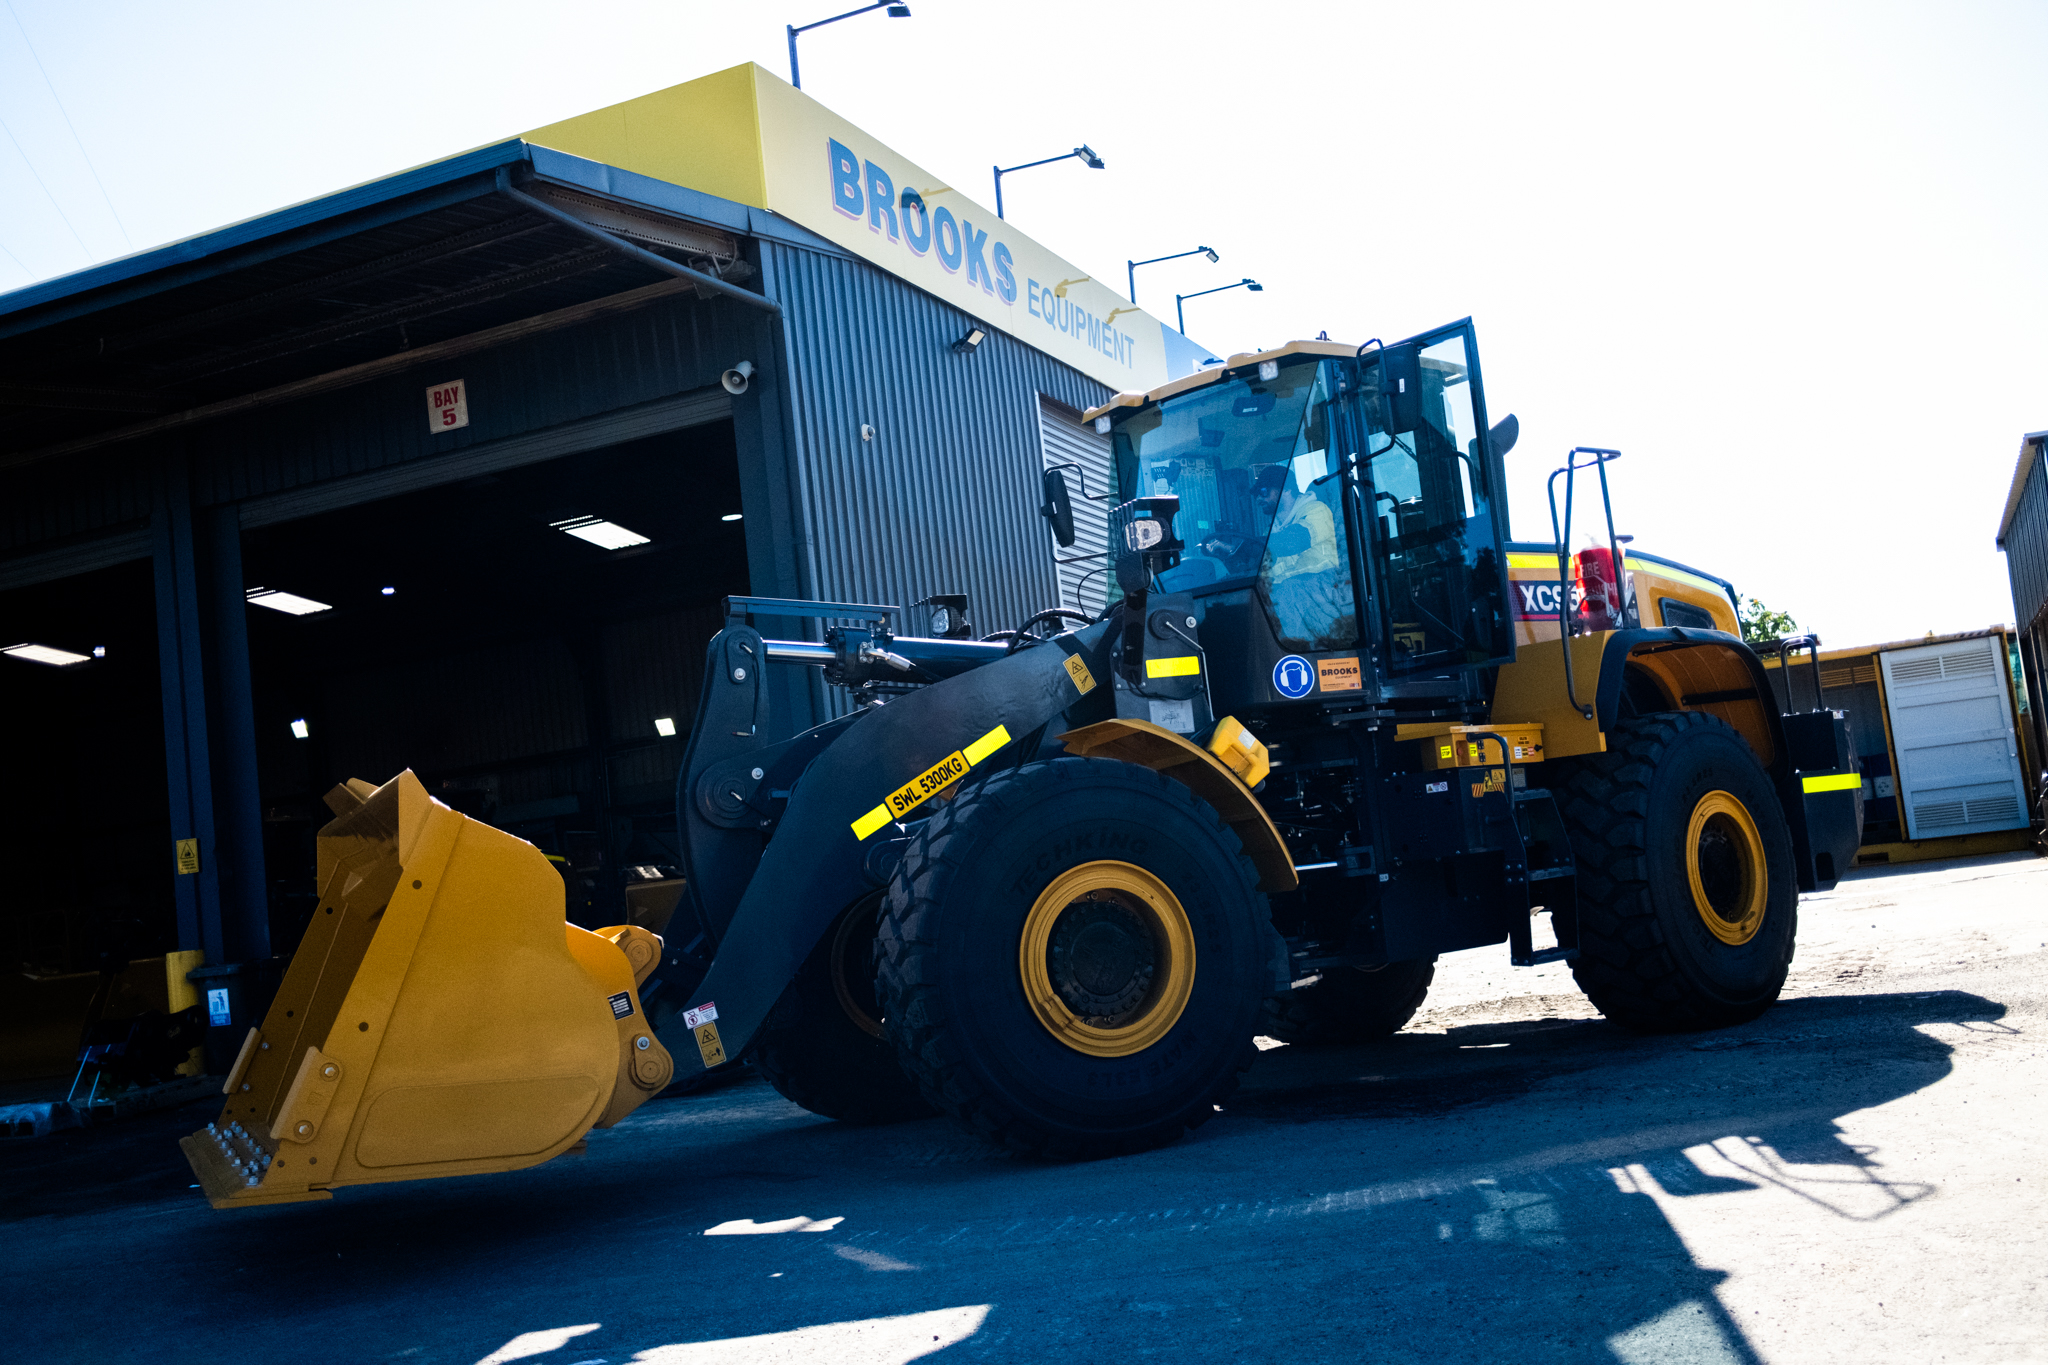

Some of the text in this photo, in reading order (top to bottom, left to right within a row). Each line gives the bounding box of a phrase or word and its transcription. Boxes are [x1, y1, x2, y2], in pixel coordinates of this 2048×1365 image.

[827, 137, 1018, 307] BROOKS
[1027, 277, 1135, 370] EQUIPMENT
[434, 386, 459, 408] BAY
[442, 408, 457, 426] 5
[1321, 667, 1358, 677] BROOKS
[893, 757, 963, 811] SWL 5300KG
